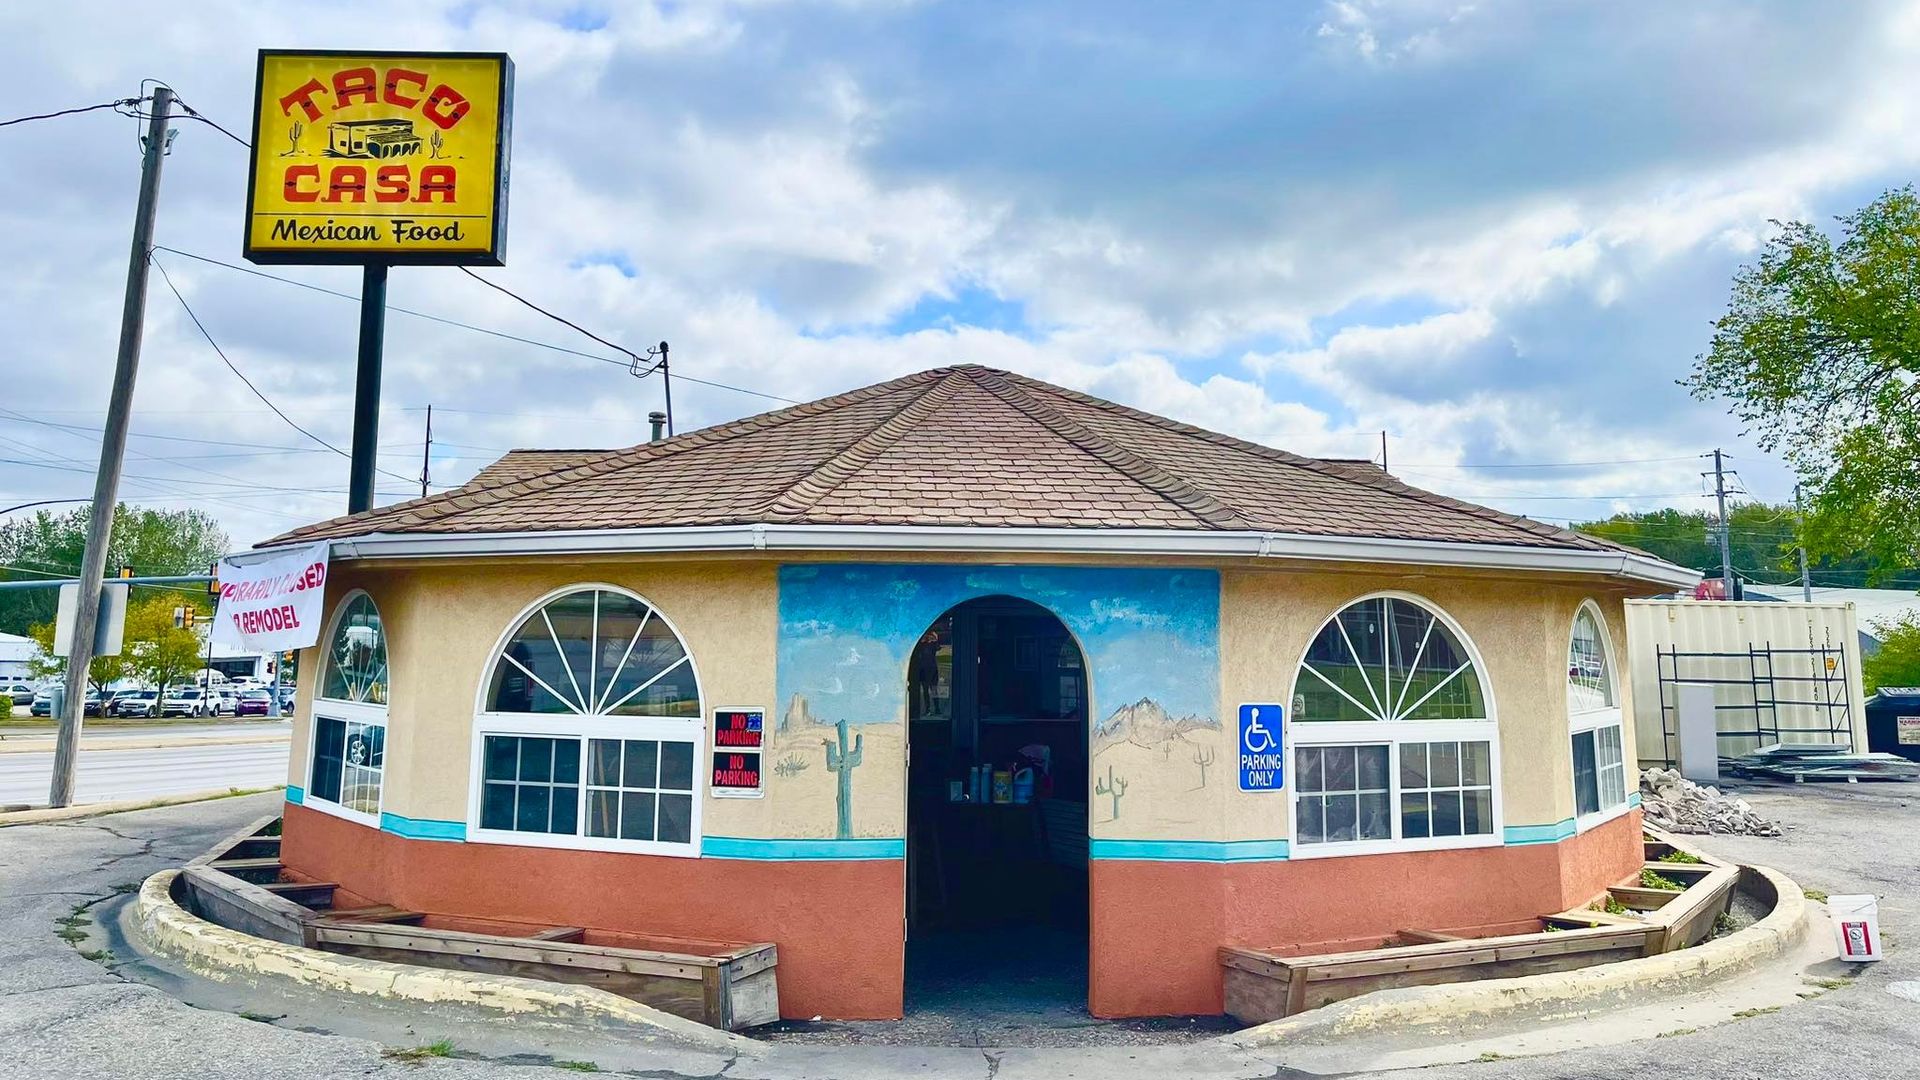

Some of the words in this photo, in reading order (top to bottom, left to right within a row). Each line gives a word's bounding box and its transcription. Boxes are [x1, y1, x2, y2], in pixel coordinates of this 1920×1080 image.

[279, 67, 471, 130] TACO
[283, 164, 457, 203] CASA
[271, 219, 381, 242] Mexican
[391, 219, 465, 243] Food
[242, 605, 300, 634] REMODEL
[730, 714, 746, 729] NO
[717, 730, 760, 745] PARKING
[729, 755, 744, 769] NO
[1241, 754, 1281, 770] PARKING
[715, 770, 758, 786] PARKING
[1248, 771, 1275, 786] ONLY
